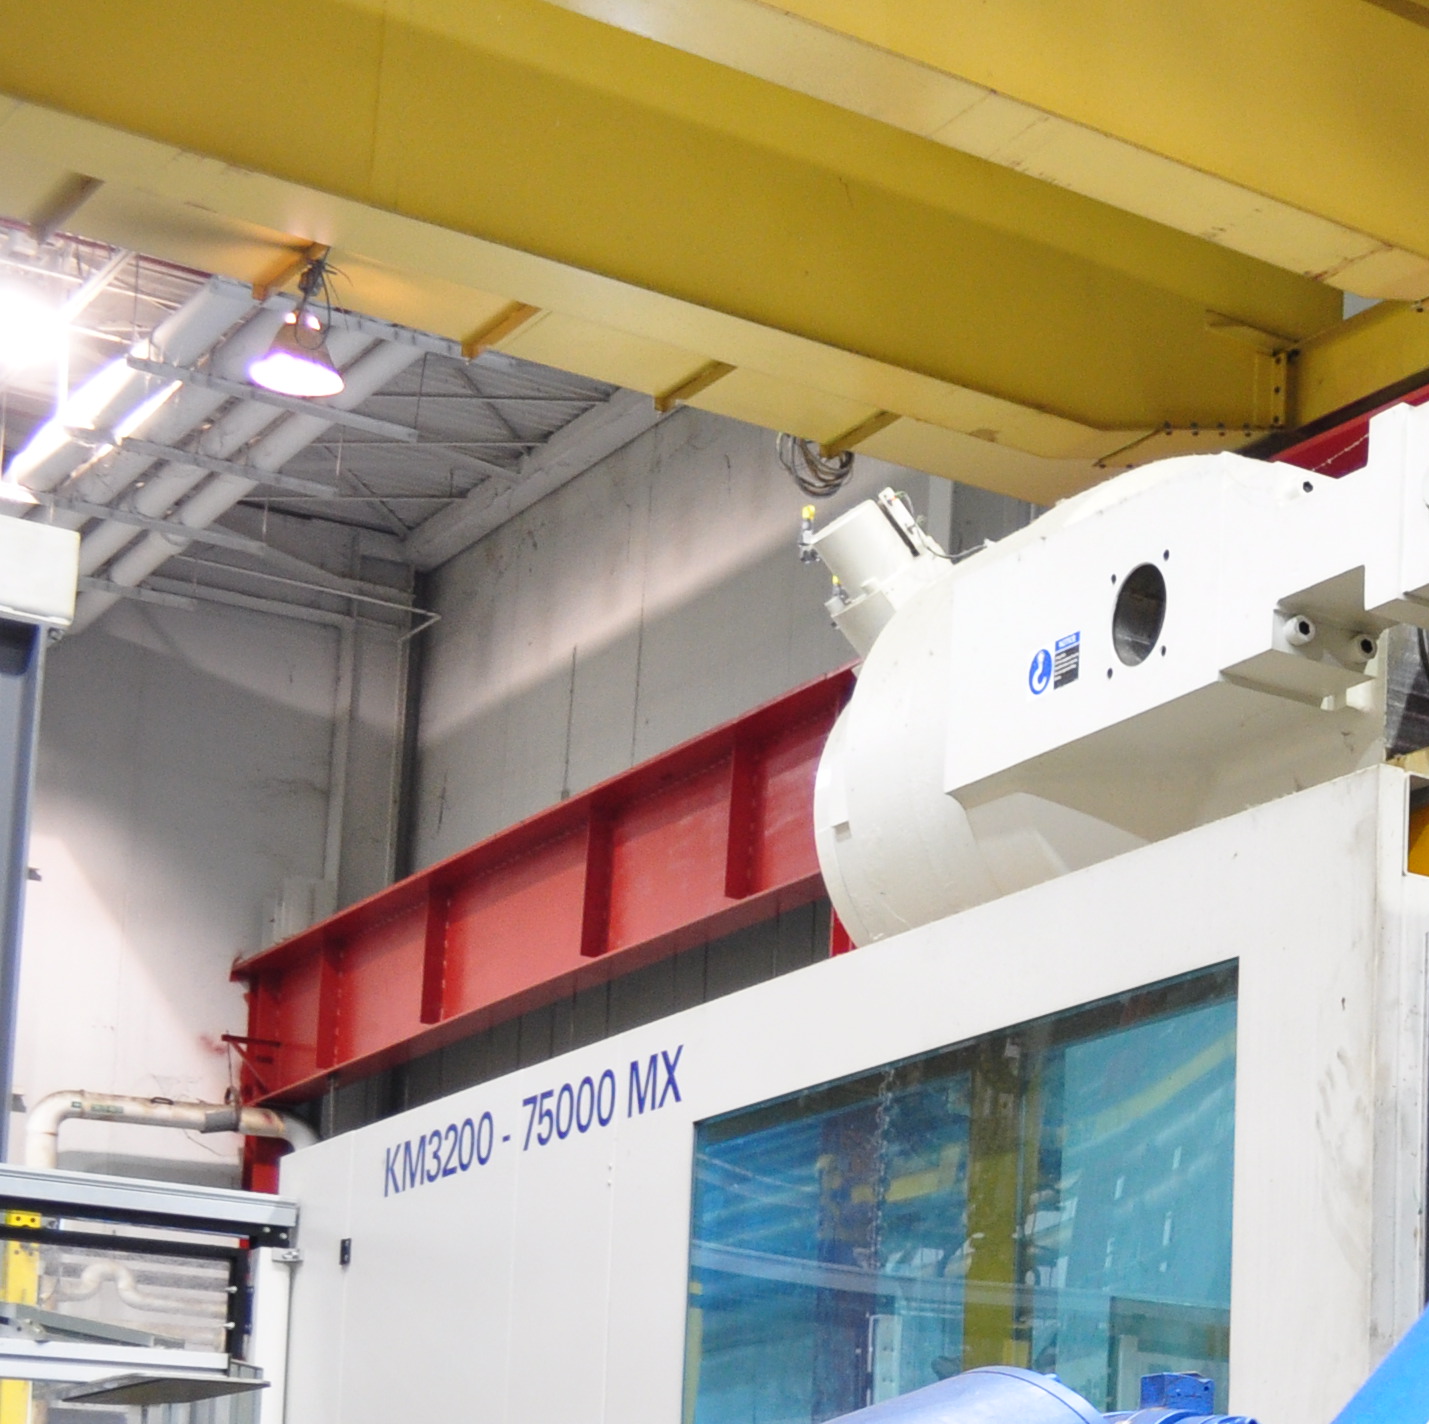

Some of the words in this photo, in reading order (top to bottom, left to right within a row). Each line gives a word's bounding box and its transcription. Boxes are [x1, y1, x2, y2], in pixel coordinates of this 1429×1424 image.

[383, 1111, 494, 1198] KM3200
[522, 1069, 616, 1152] 75000
[627, 1045, 684, 1118] MX
